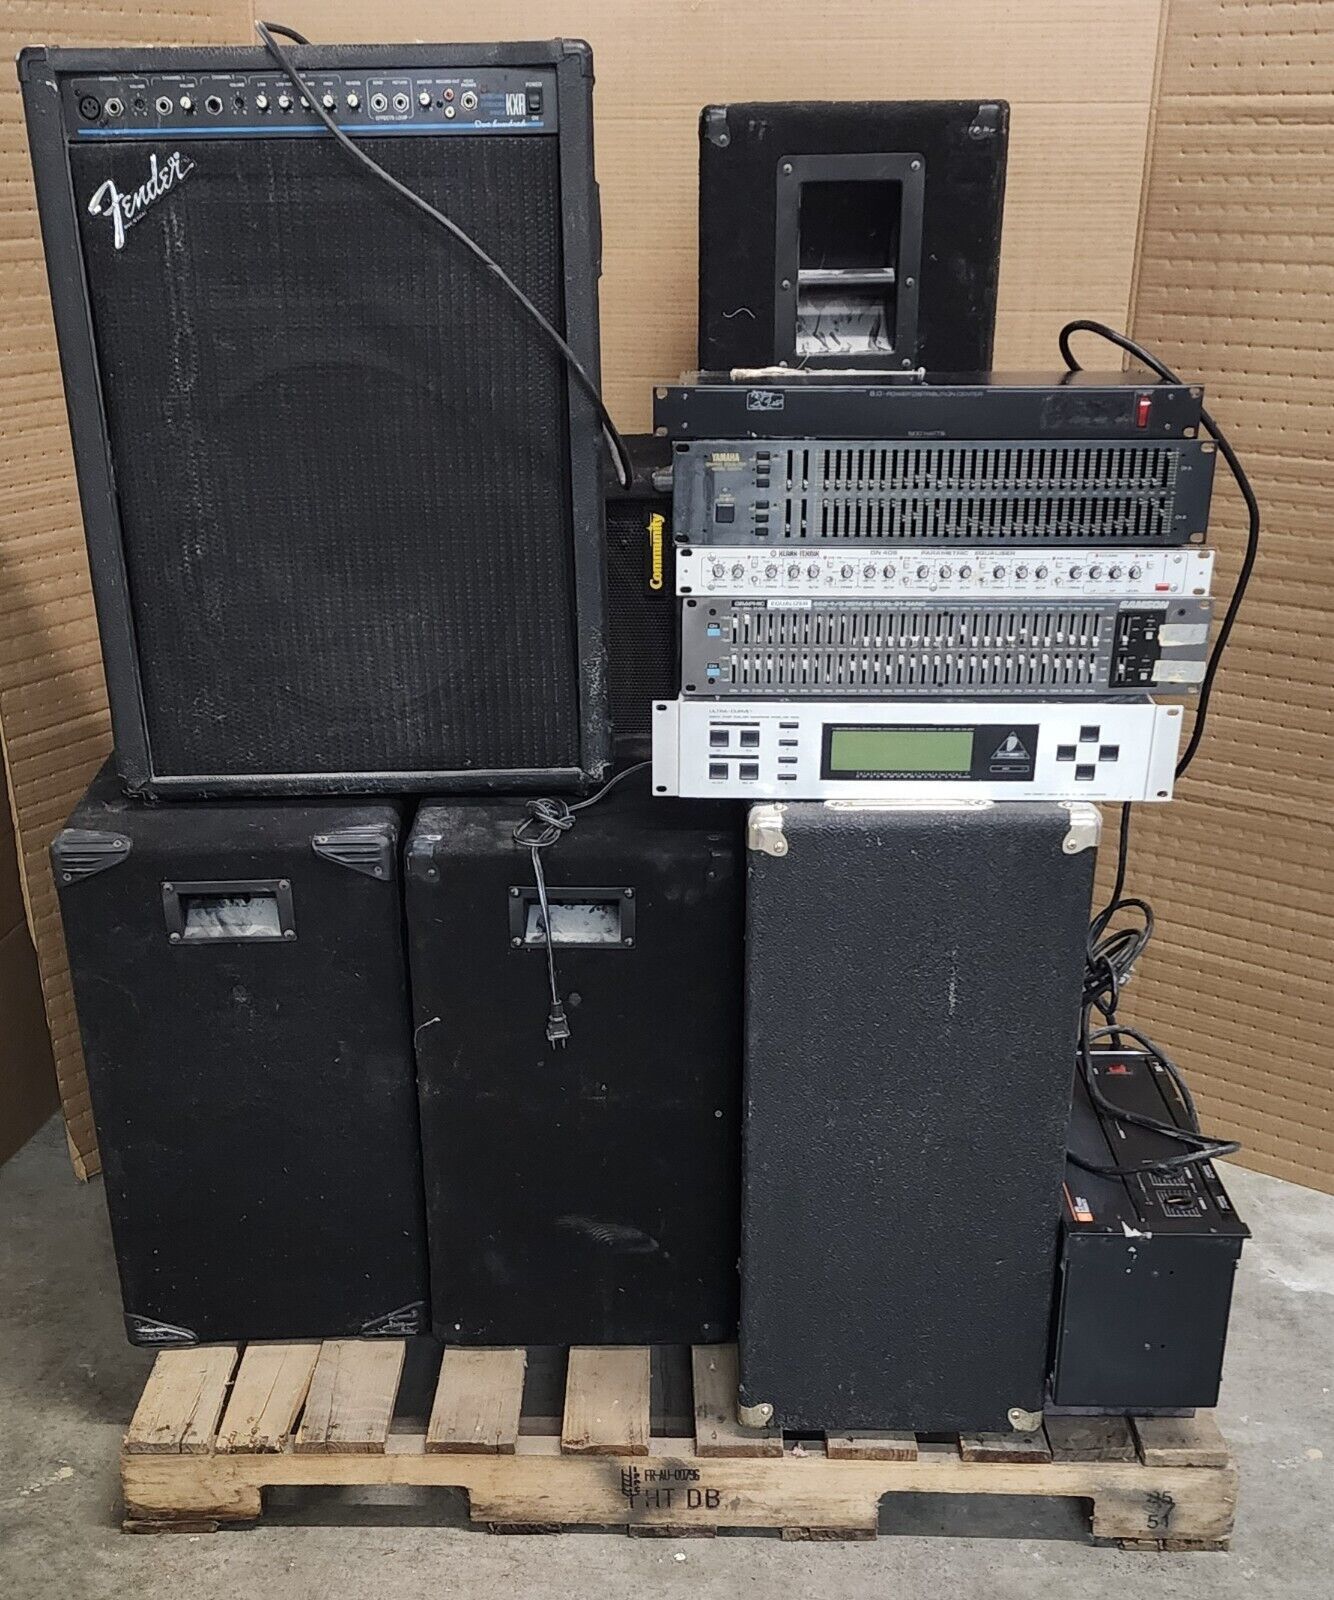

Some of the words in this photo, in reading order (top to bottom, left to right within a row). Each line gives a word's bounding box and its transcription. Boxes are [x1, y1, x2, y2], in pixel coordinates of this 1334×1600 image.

[87, 151, 194, 250] Fender
[711, 452, 740, 462] YAMAHA
[687, 1488, 721, 1508] DB
